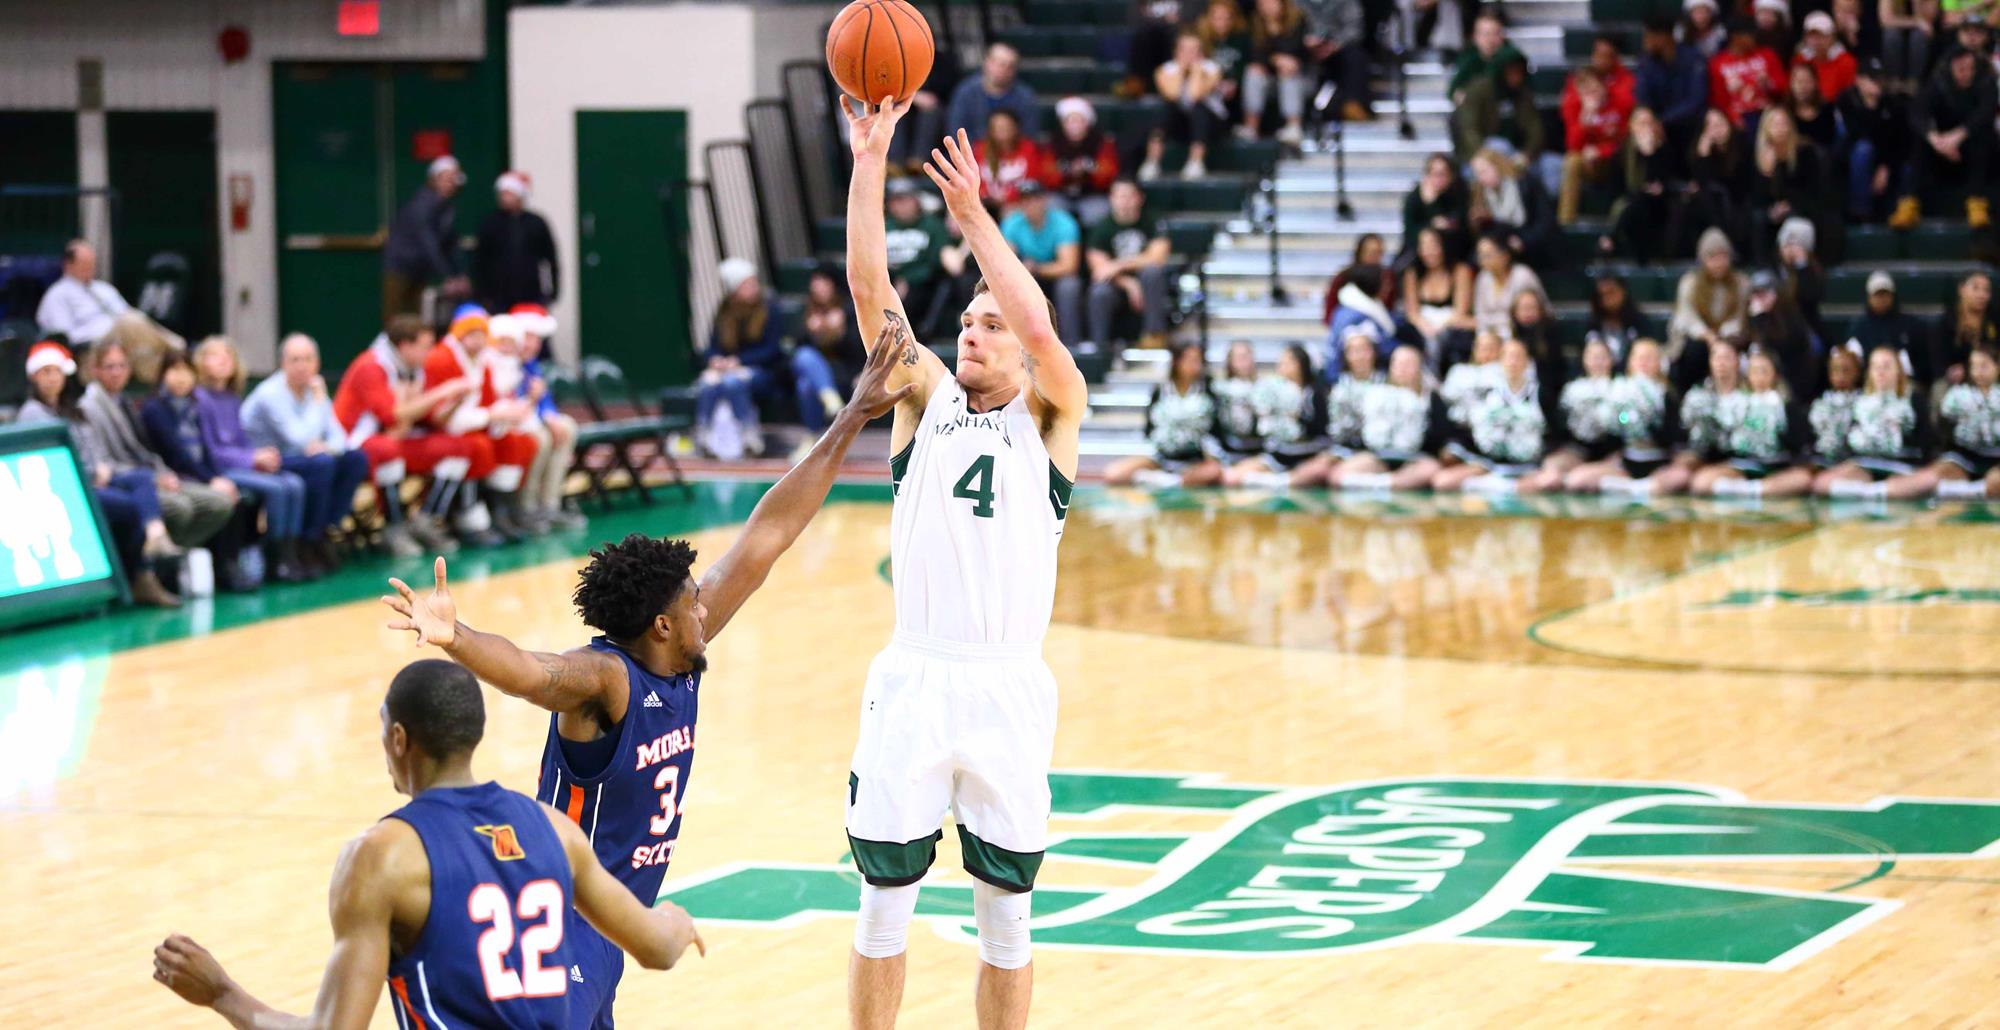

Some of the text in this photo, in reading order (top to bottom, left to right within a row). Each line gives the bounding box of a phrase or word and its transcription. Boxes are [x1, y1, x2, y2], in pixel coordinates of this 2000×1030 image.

[953, 454, 995, 518] 4
[649, 765, 685, 836] 3
[1136, 787, 1559, 939] JASPERS
[467, 878, 567, 1002] 22
